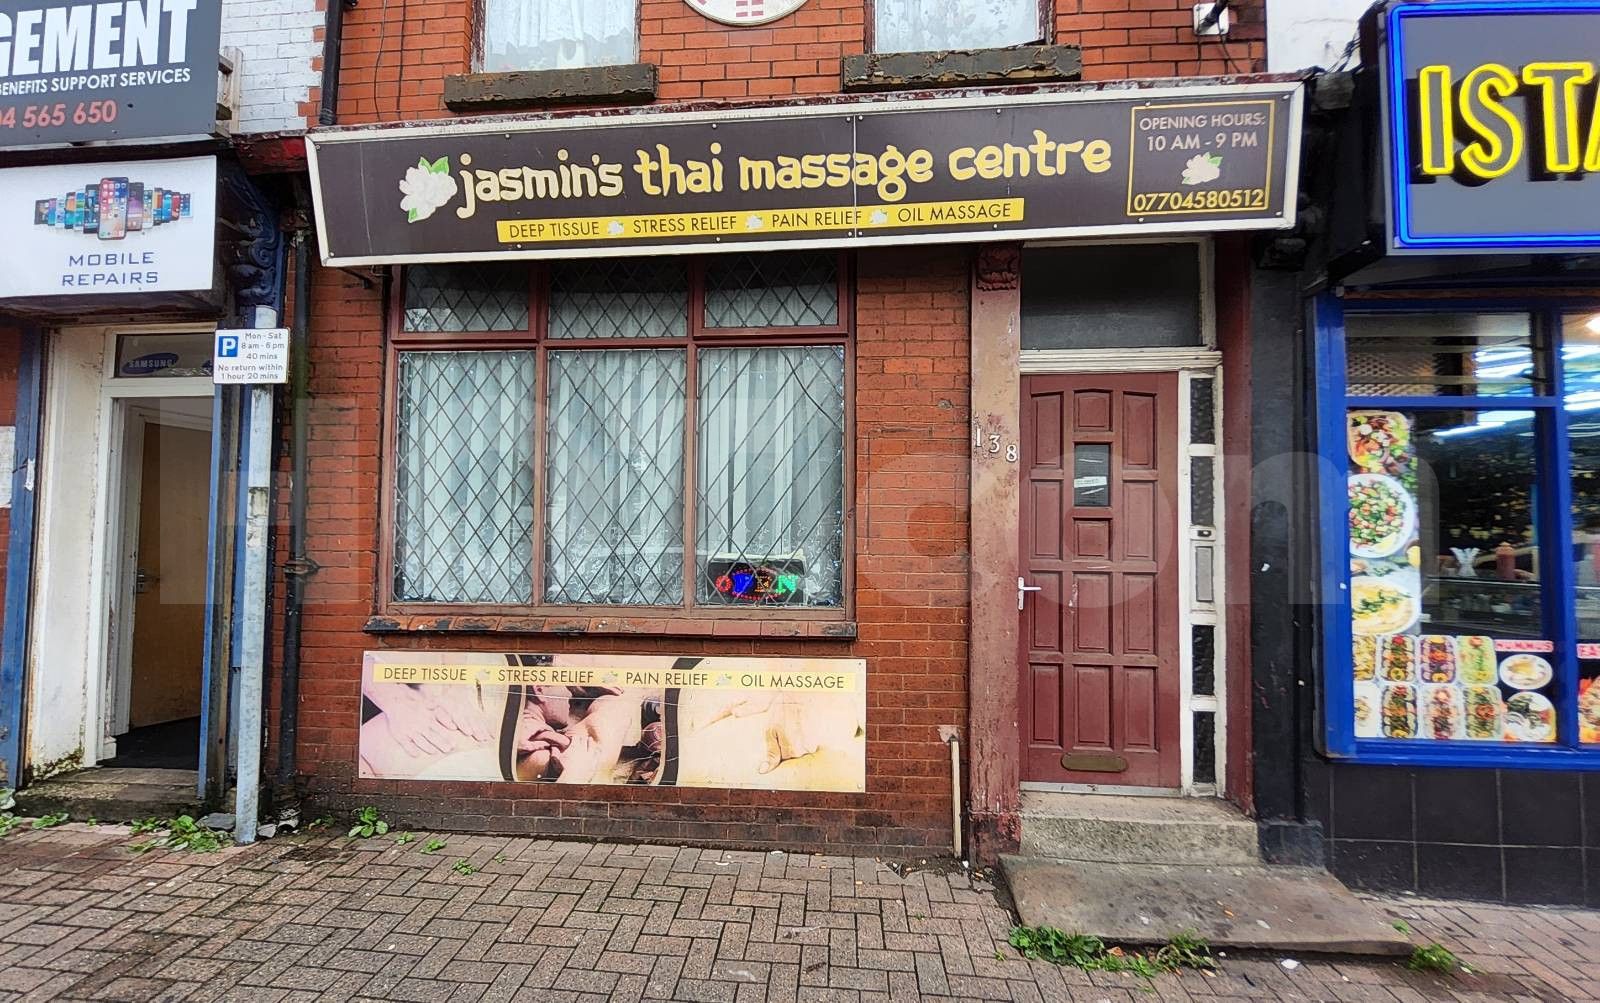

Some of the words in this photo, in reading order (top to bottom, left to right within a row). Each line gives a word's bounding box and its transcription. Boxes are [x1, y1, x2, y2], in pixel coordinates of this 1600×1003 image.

[51, 73, 117, 92] SUPPORT
[120, 68, 191, 87] SERVICES
[22, 103, 66, 128] 565
[73, 101, 117, 125] 650
[1139, 115, 1208, 131] OPENING
[1420, 62, 1600, 178] IST
[1147, 135, 1166, 151] 10
[1170, 134, 1200, 151] AM
[1215, 132, 1226, 149] 9
[1231, 132, 1258, 148] PM
[456, 149, 623, 219] jasmin's
[633, 142, 724, 197] thai
[739, 144, 934, 202] massage
[948, 129, 1112, 181] centre
[1133, 188, 1265, 211] 07704580512
[509, 224, 545, 238] DEEP
[550, 221, 600, 237] TISSUE
[633, 217, 686, 234] STRESS
[691, 215, 737, 231] RELIEF
[772, 212, 808, 228] PAIN
[814, 210, 862, 226] RELIEF
[898, 208, 925, 222] OIL
[929, 203, 1011, 221] MASSAGE
[69, 252, 155, 267] MOBILE
[62, 271, 158, 286] REPAIRS
[245, 332, 262, 340] Mon
[268, 332, 282, 340] Sat
[227, 372, 244, 380] hour
[260, 372, 278, 380] mins
[383, 667, 417, 681] DEEP
[421, 668, 467, 681] TISSUE
[497, 669, 546, 682] STRESS
[551, 670, 594, 683] RELIEF
[625, 671, 660, 685] PAIN
[664, 672, 708, 686] RELIEF
[740, 674, 765, 687] OIL
[769, 674, 845, 689] MASSAGE
